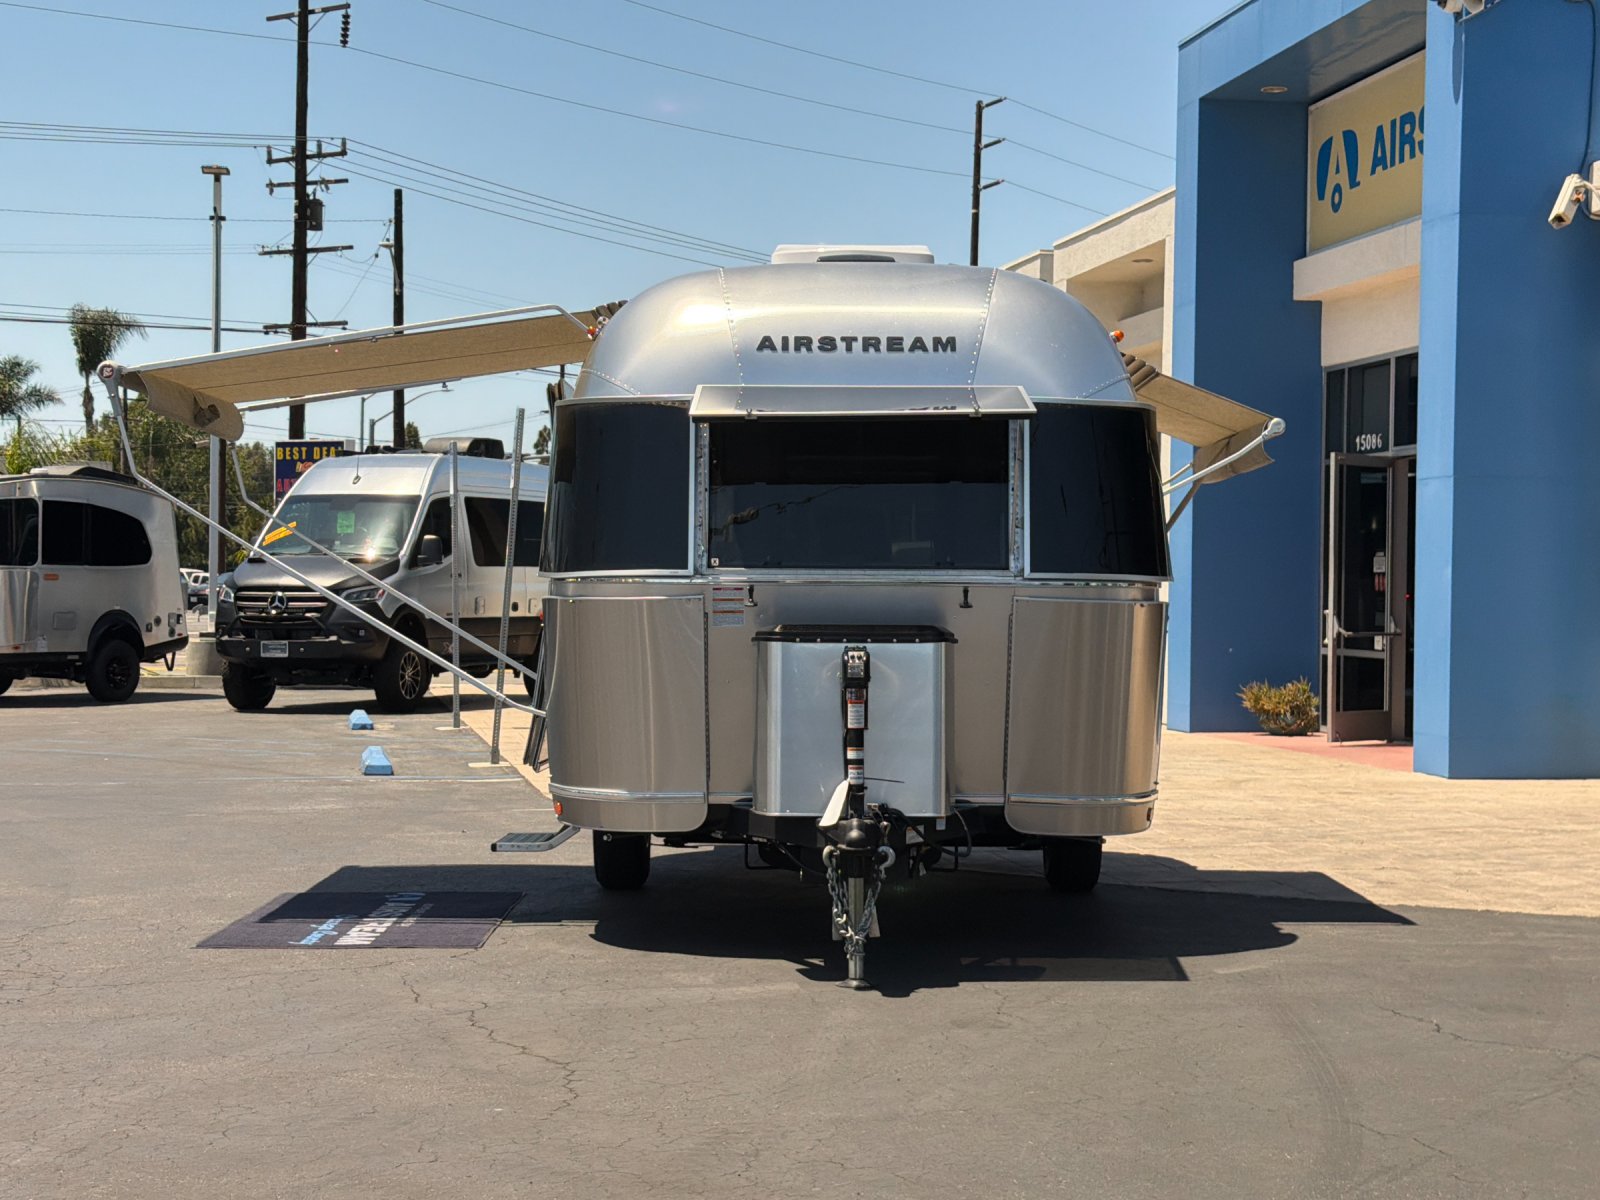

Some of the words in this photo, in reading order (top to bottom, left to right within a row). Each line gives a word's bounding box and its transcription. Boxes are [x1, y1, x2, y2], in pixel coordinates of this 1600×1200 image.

[756, 335, 957, 353] AIRSTREAM
[1355, 433, 1383, 452] 15086
[277, 447, 307, 460] BEST
[313, 446, 342, 459] DEA
